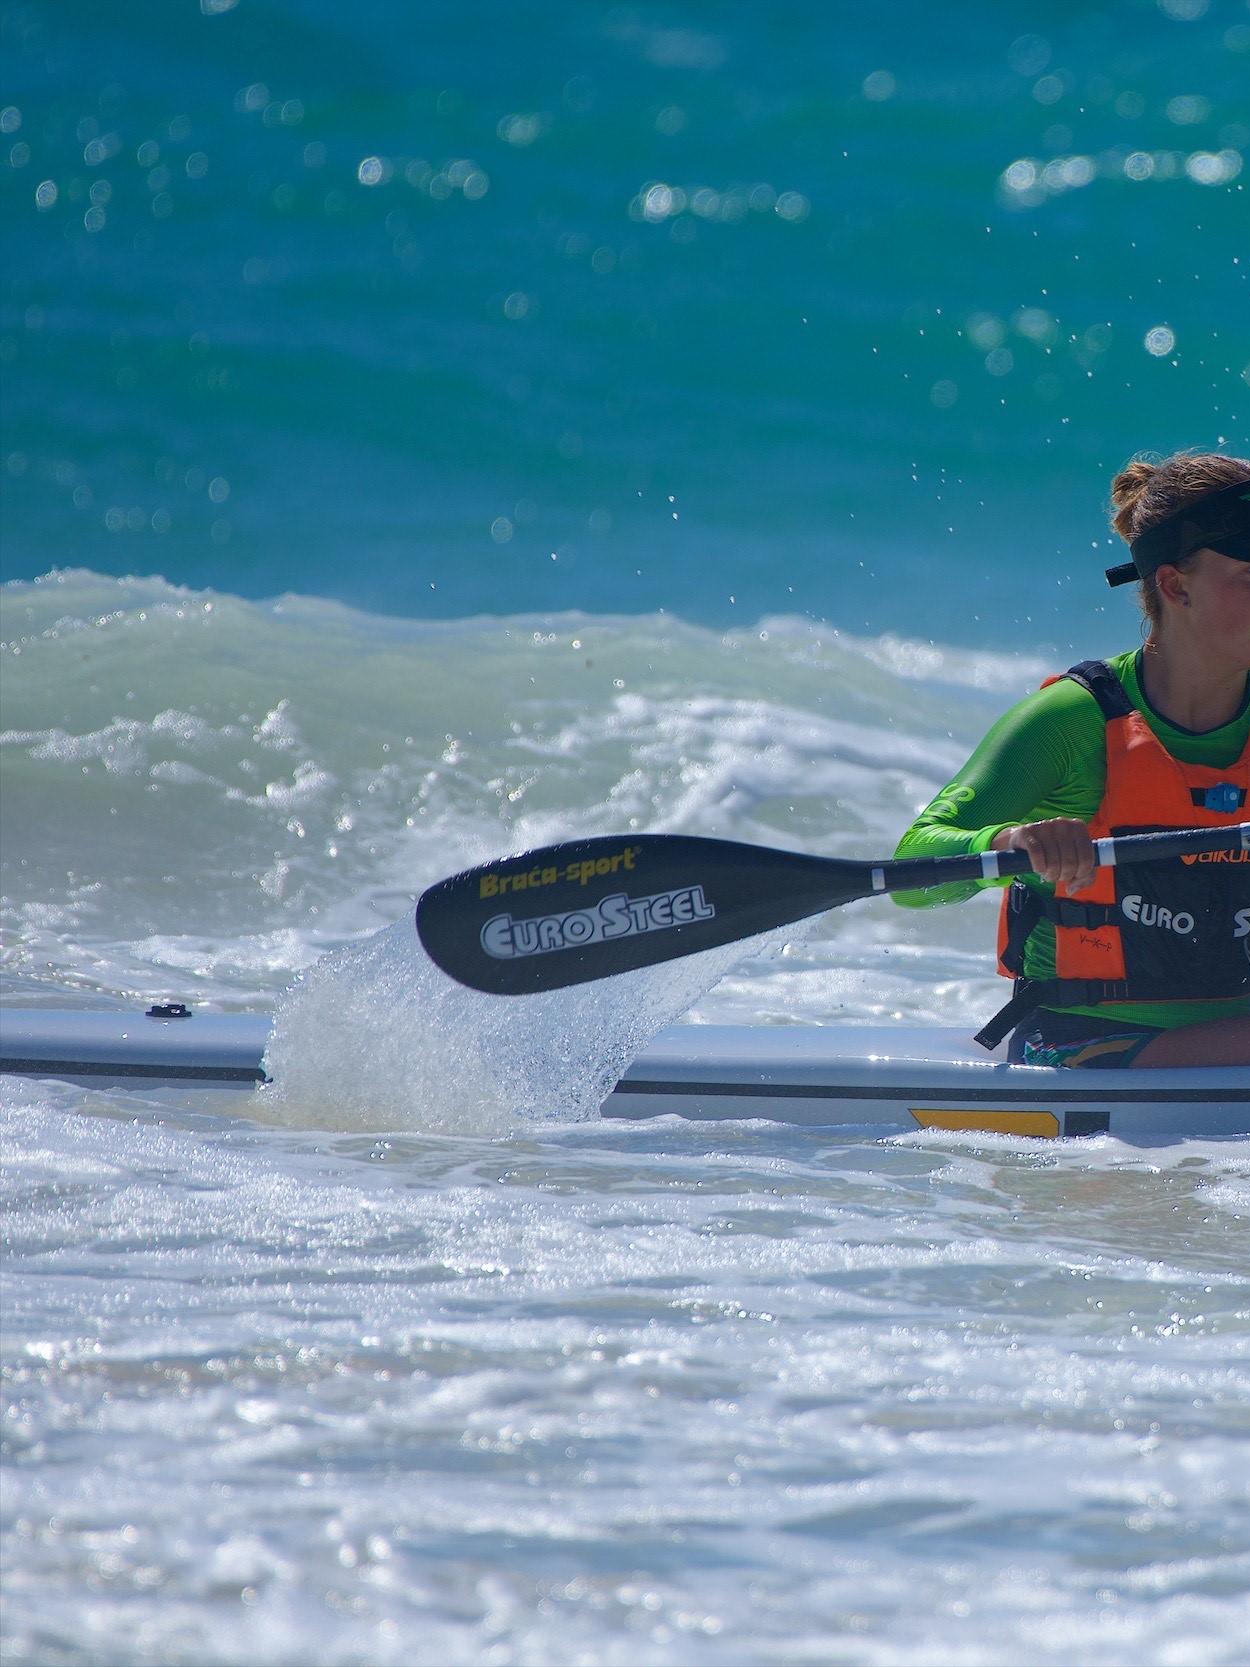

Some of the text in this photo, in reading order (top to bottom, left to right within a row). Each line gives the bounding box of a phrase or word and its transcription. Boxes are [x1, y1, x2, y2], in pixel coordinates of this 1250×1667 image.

[483, 887, 714, 956] EURO STEEL
[1121, 894, 1195, 934] EURO
